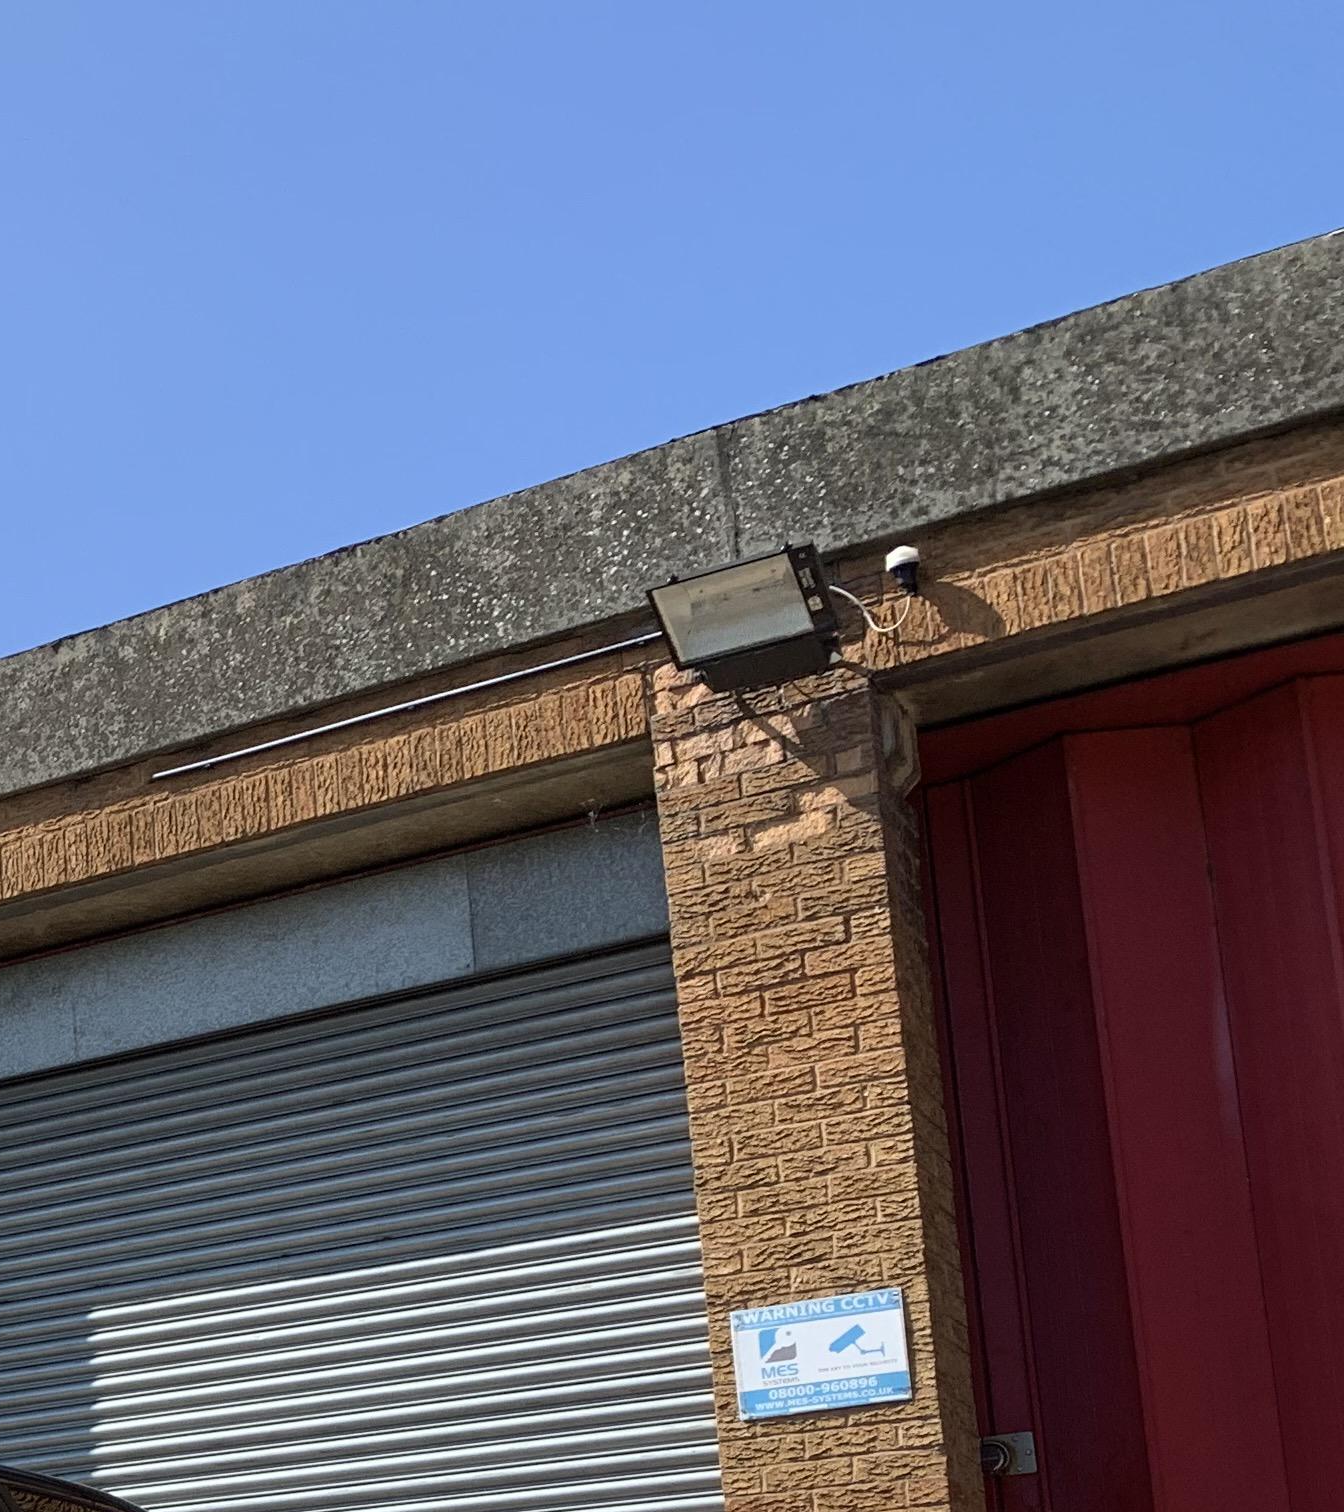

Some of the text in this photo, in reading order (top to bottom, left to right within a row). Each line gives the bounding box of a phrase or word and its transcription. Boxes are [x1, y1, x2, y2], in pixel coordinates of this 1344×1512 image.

[741, 1292, 890, 1325] WARNING CCTV
[761, 1363, 799, 1380] MES
[762, 1377, 800, 1386] SYSTEMS
[768, 1376, 878, 1400] 08000-960896
